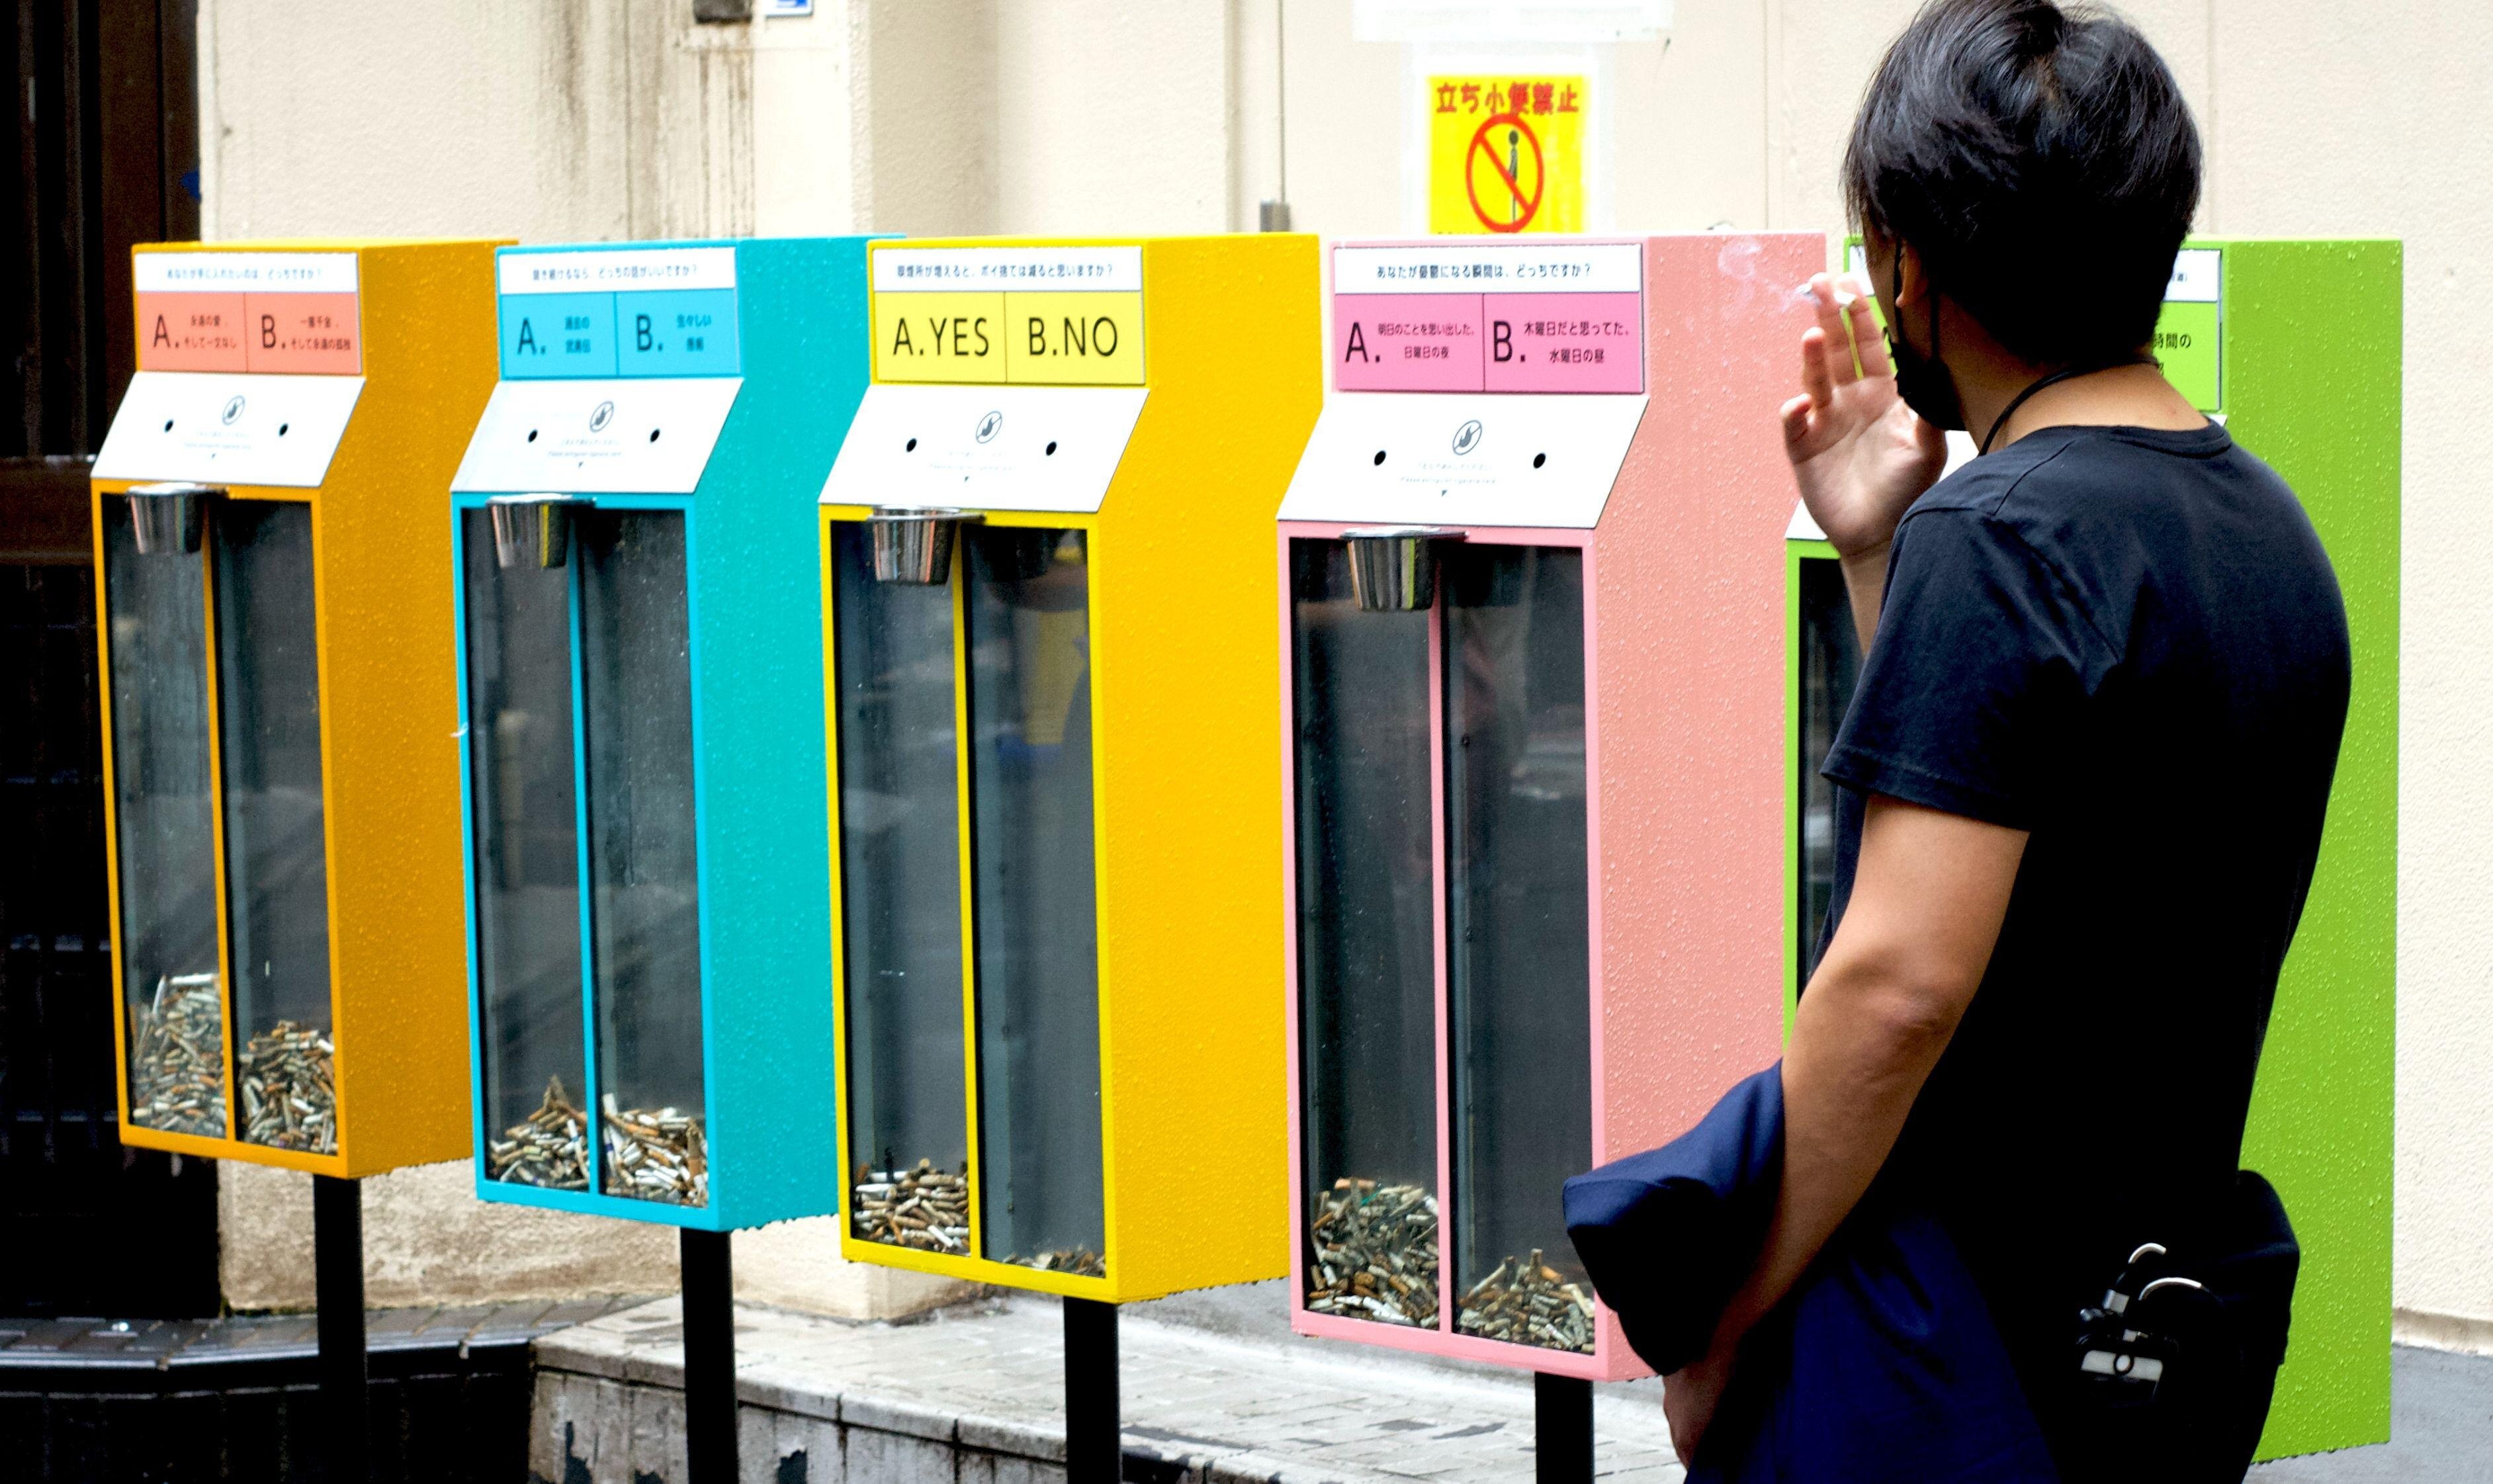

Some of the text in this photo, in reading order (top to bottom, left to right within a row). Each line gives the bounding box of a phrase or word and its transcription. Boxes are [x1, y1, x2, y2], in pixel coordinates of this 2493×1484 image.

[1436, 81, 1579, 115] 立ち小便禁止
[893, 318, 988, 357] A.YES
[1029, 317, 1117, 357] B.NO
[1405, 347, 1448, 359] 日曜日の夜
[1550, 349, 1604, 363] 水曜日の昼
